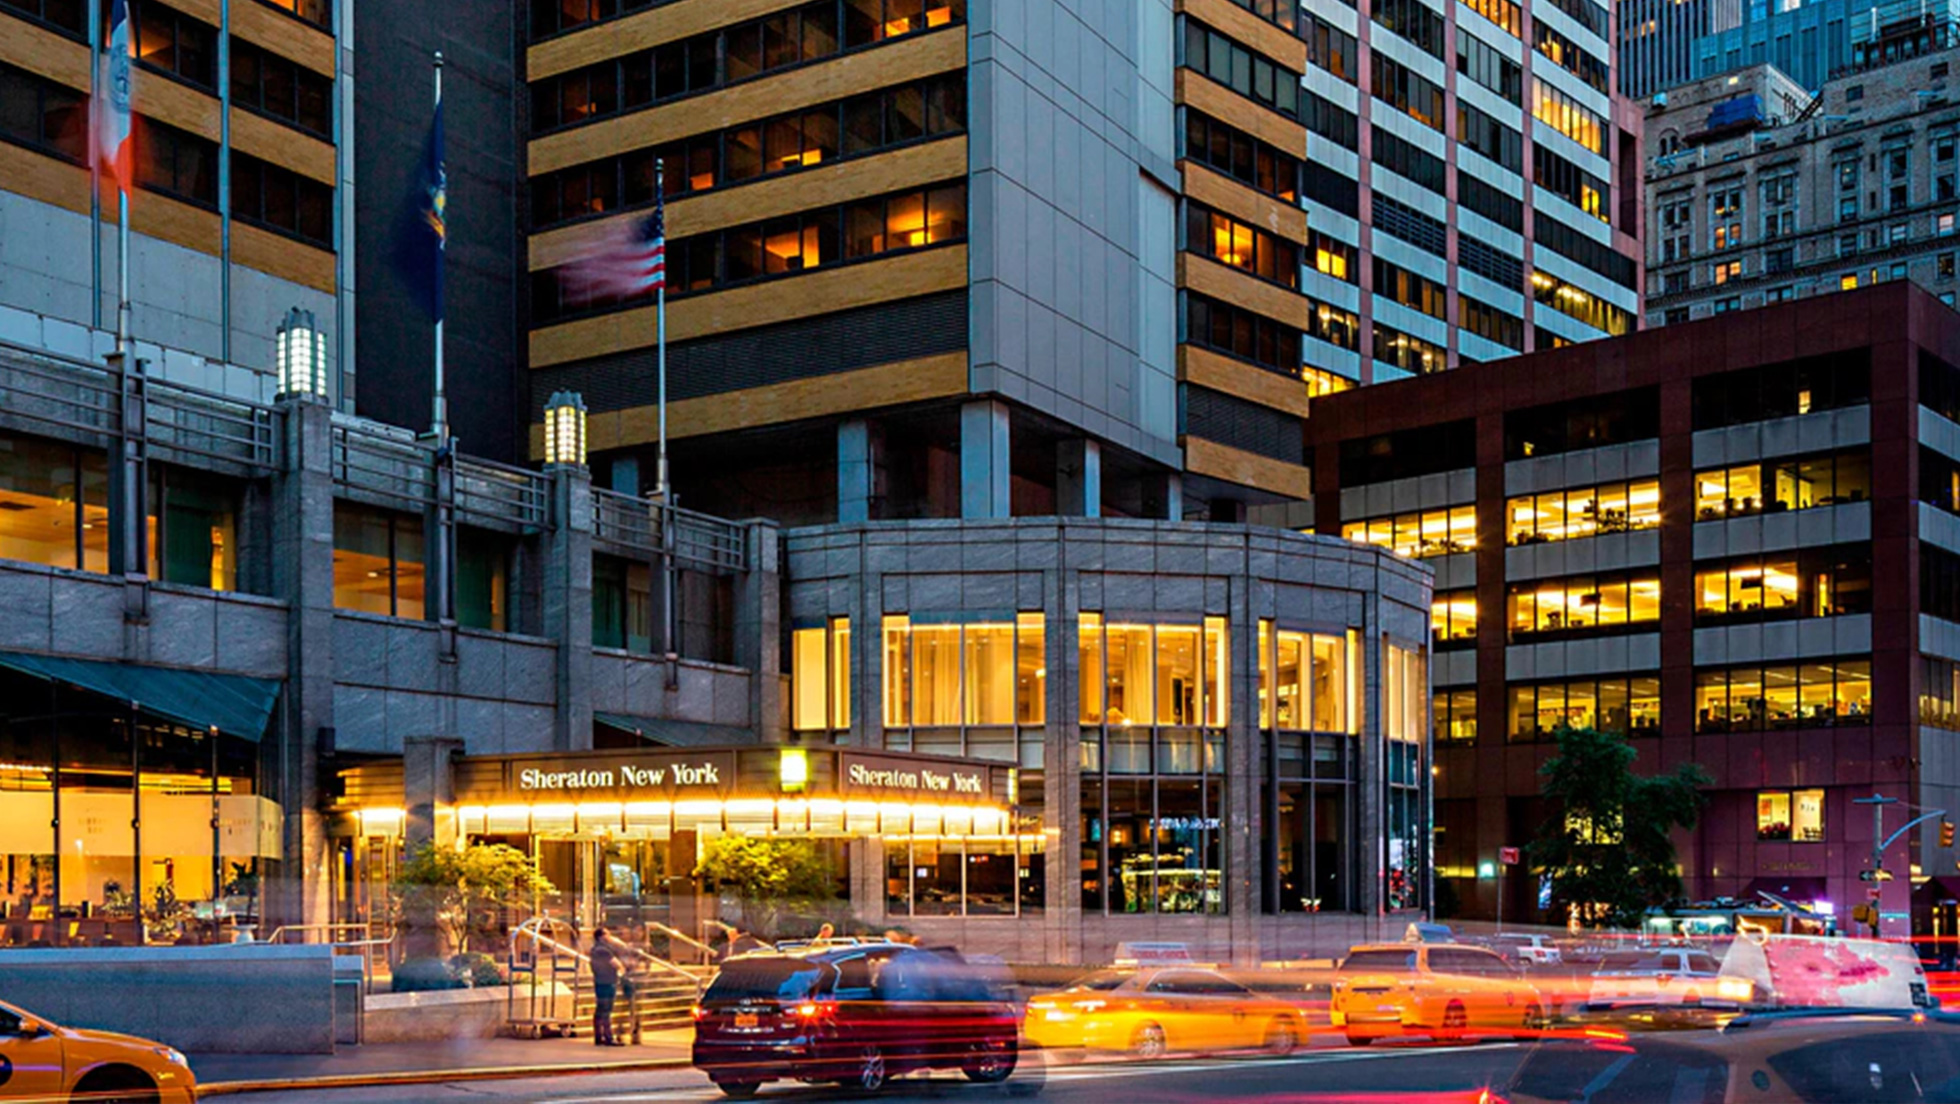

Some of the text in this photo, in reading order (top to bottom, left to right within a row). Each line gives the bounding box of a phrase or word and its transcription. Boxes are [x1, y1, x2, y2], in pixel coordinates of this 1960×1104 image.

[520, 763, 719, 789] Sheraton New York
[849, 763, 982, 793] Sheraton New York
